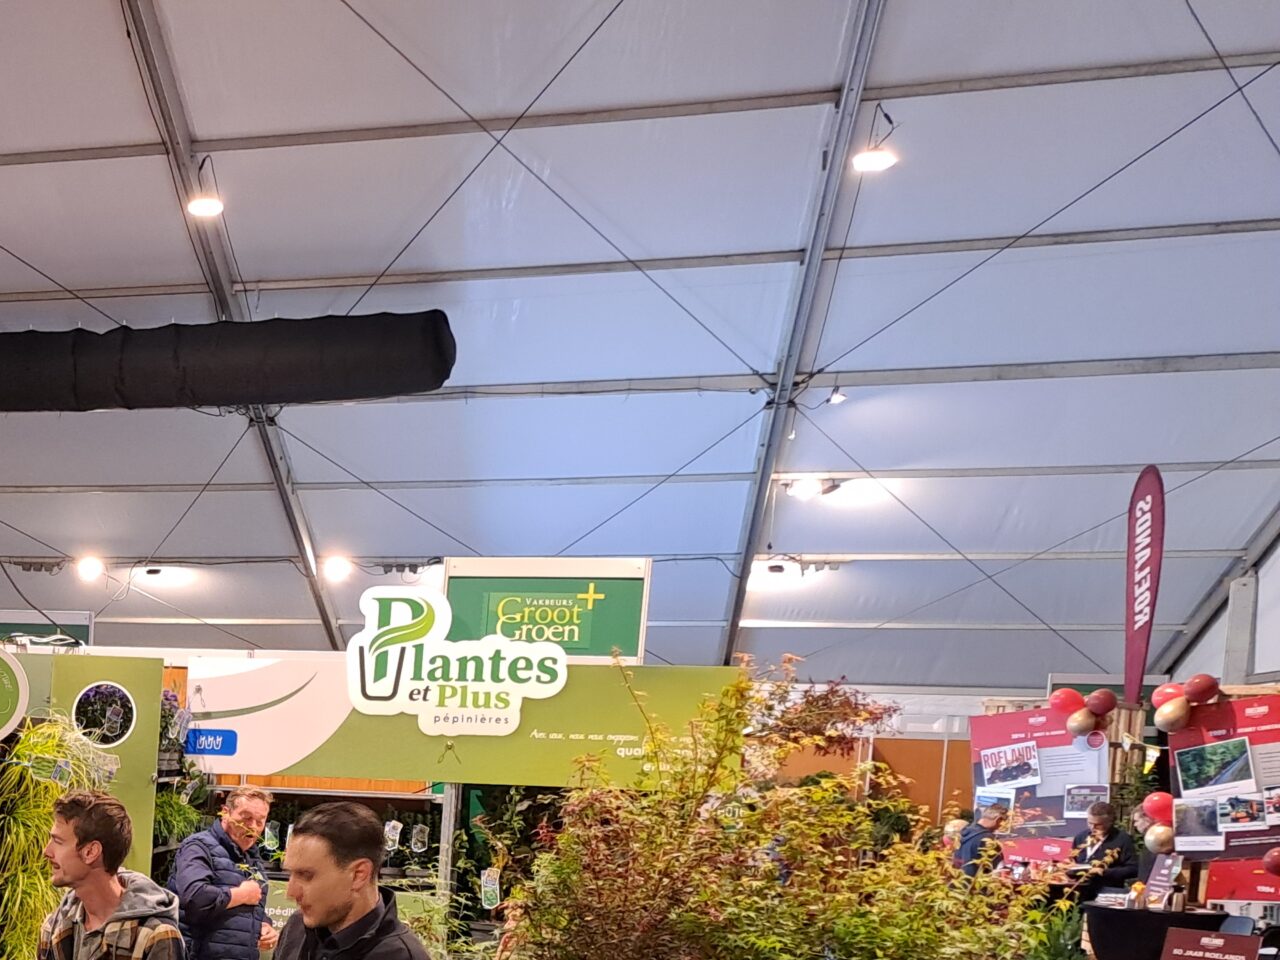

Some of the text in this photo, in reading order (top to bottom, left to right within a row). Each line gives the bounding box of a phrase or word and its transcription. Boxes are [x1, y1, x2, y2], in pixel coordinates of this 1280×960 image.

[497, 597, 582, 624] Groot
[525, 597, 573, 606] VAKBEURS
[496, 614, 580, 642] Groen
[408, 684, 511, 710] et Plus
[433, 713, 510, 725] pépinières
